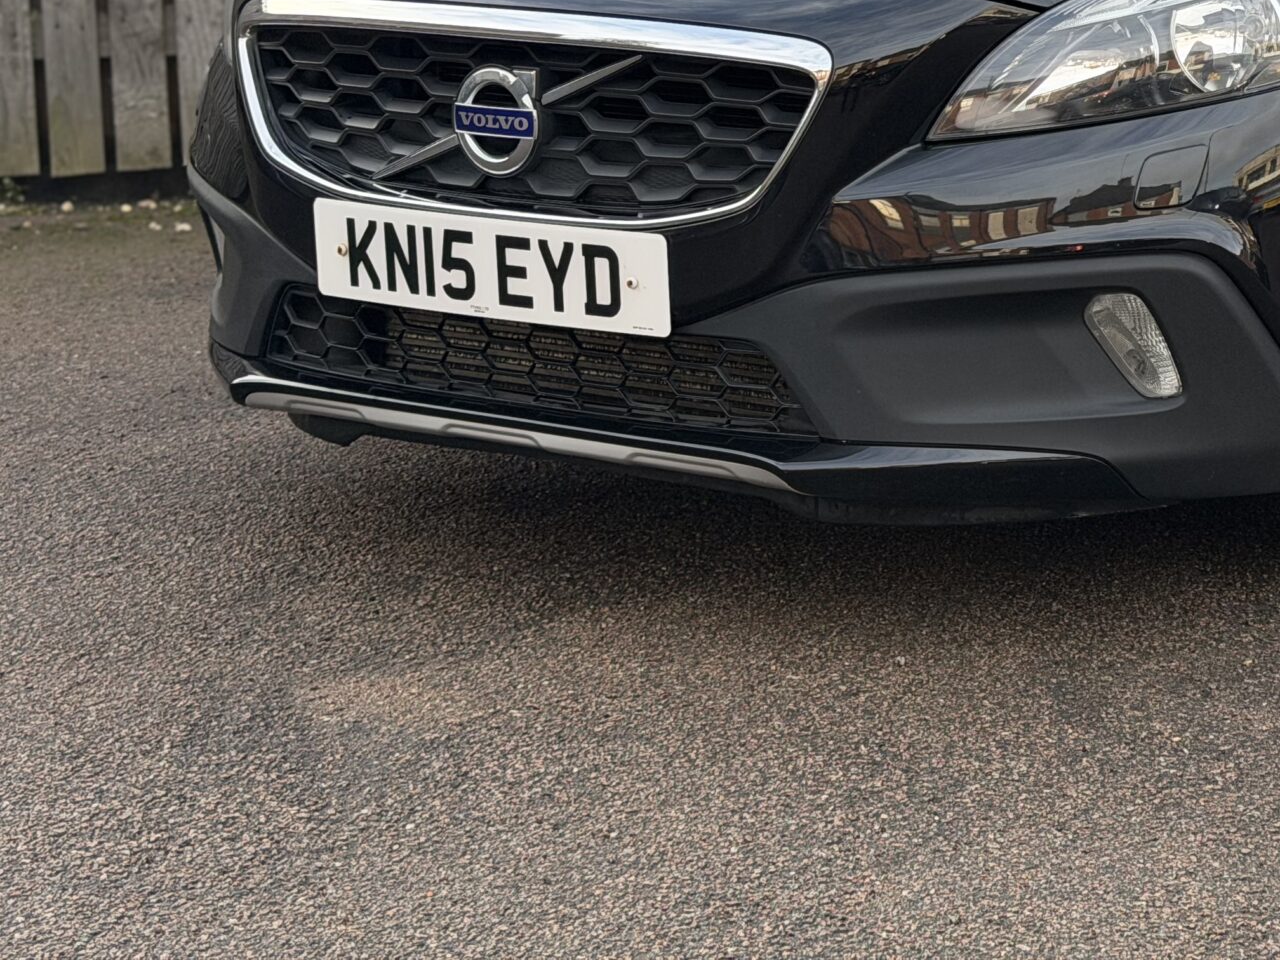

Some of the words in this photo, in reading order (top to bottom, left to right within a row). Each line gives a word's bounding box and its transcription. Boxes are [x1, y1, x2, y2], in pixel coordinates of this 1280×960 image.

[458, 111, 529, 131] VOLVO
[346, 217, 476, 302] KN15
[495, 234, 622, 318] EYD
